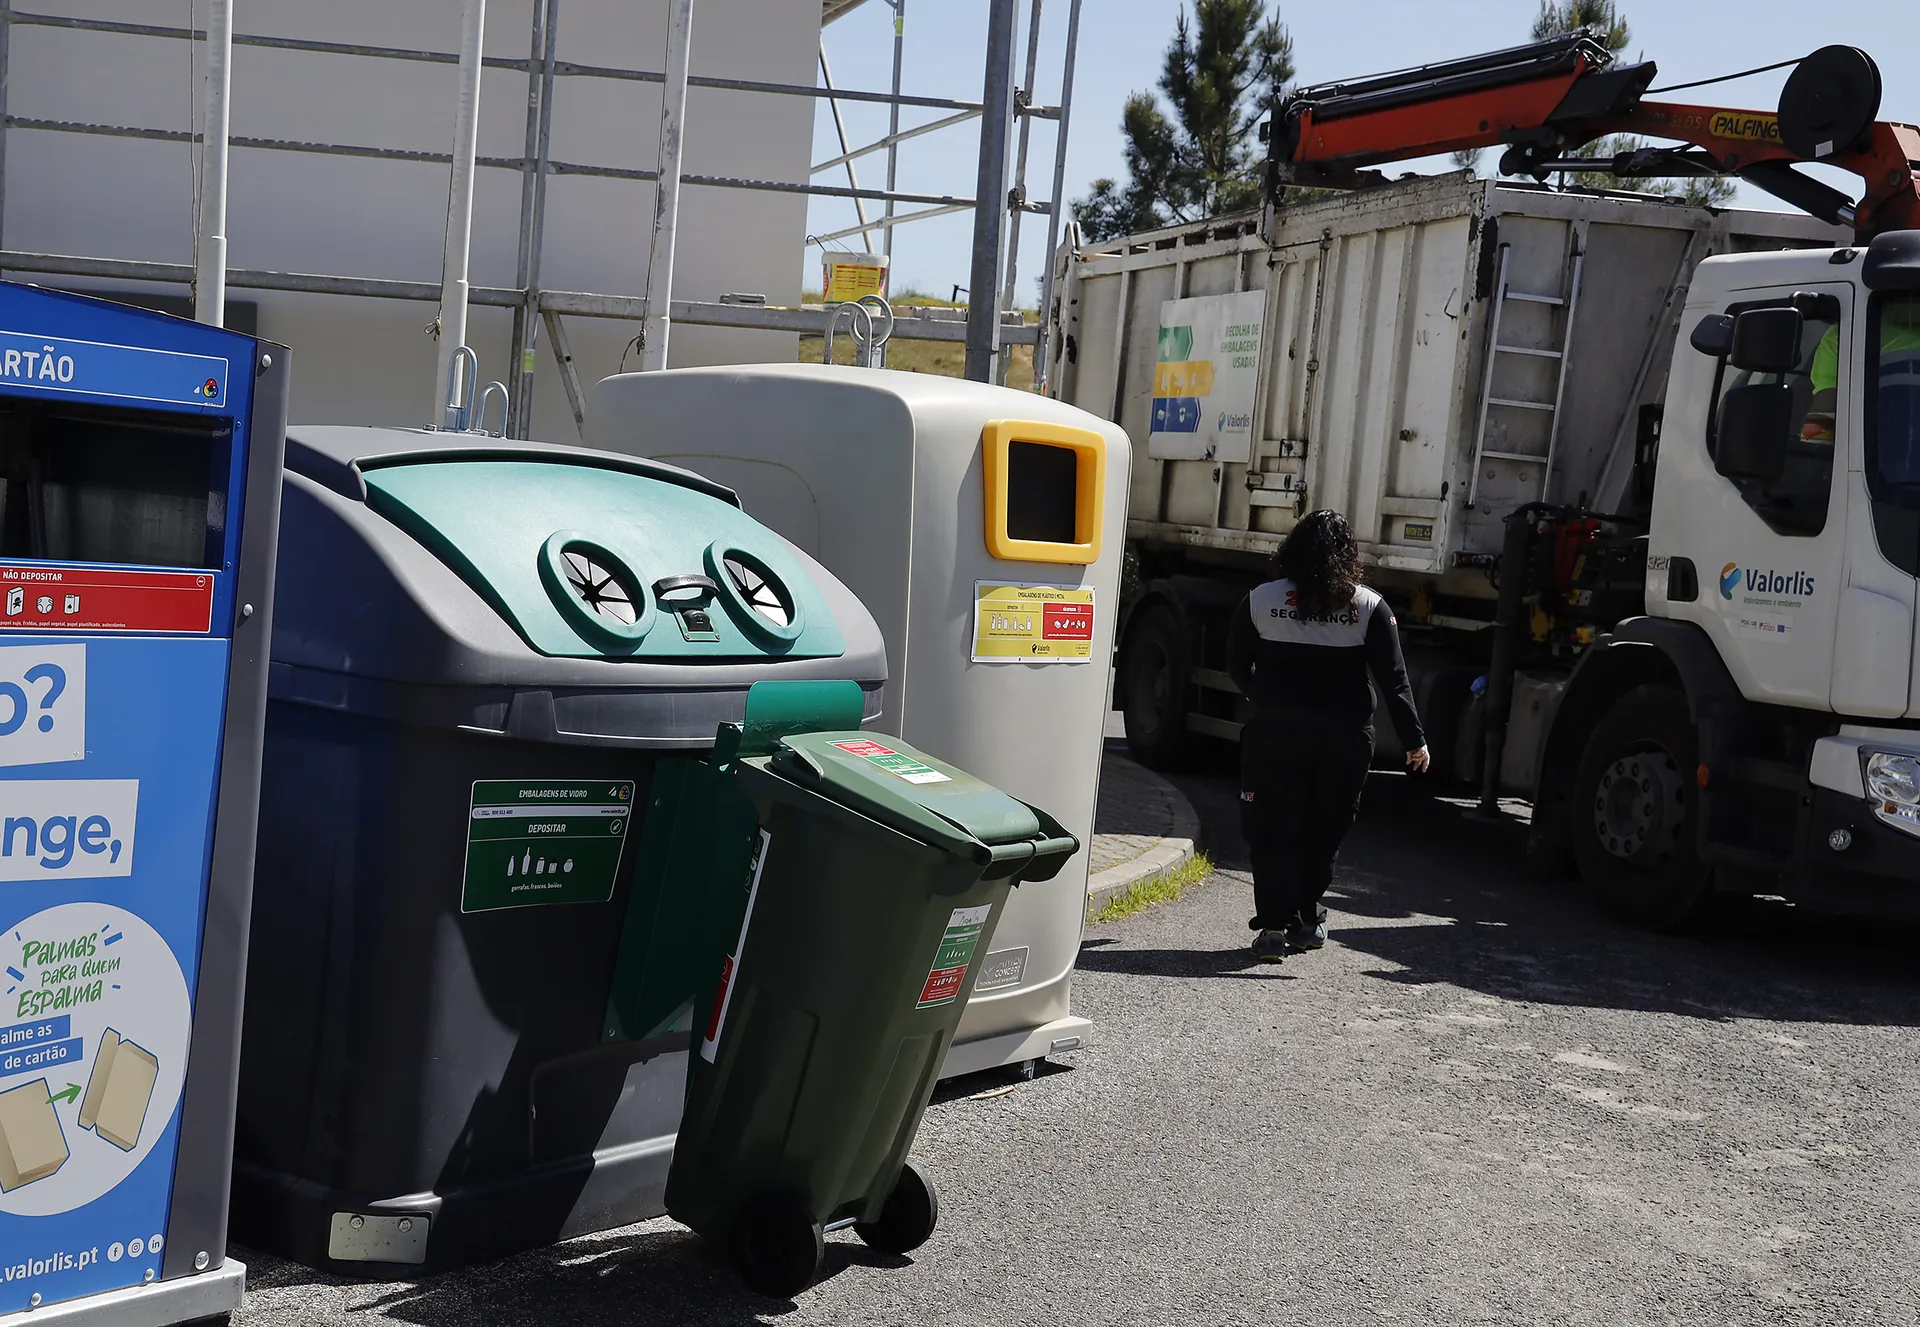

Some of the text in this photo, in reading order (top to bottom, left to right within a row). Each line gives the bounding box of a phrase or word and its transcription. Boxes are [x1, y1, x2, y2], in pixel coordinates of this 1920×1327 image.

[1225, 324, 1259, 338] RECOLHA DE
[1221, 340, 1258, 353] EMBALAGENS
[1232, 356, 1256, 369] USADAS
[1227, 414, 1250, 427] Valorlis
[3, 569, 63, 582] NÃO DEPOSITAR
[1746, 569, 1815, 596] Valorlis
[518, 789, 588, 799] EMBALAGENS DE VIDRO
[528, 824, 567, 834] DEPOSITAR
[0, 1024, 53, 1045] alme as
[4, 1045, 67, 1070] de cartão
